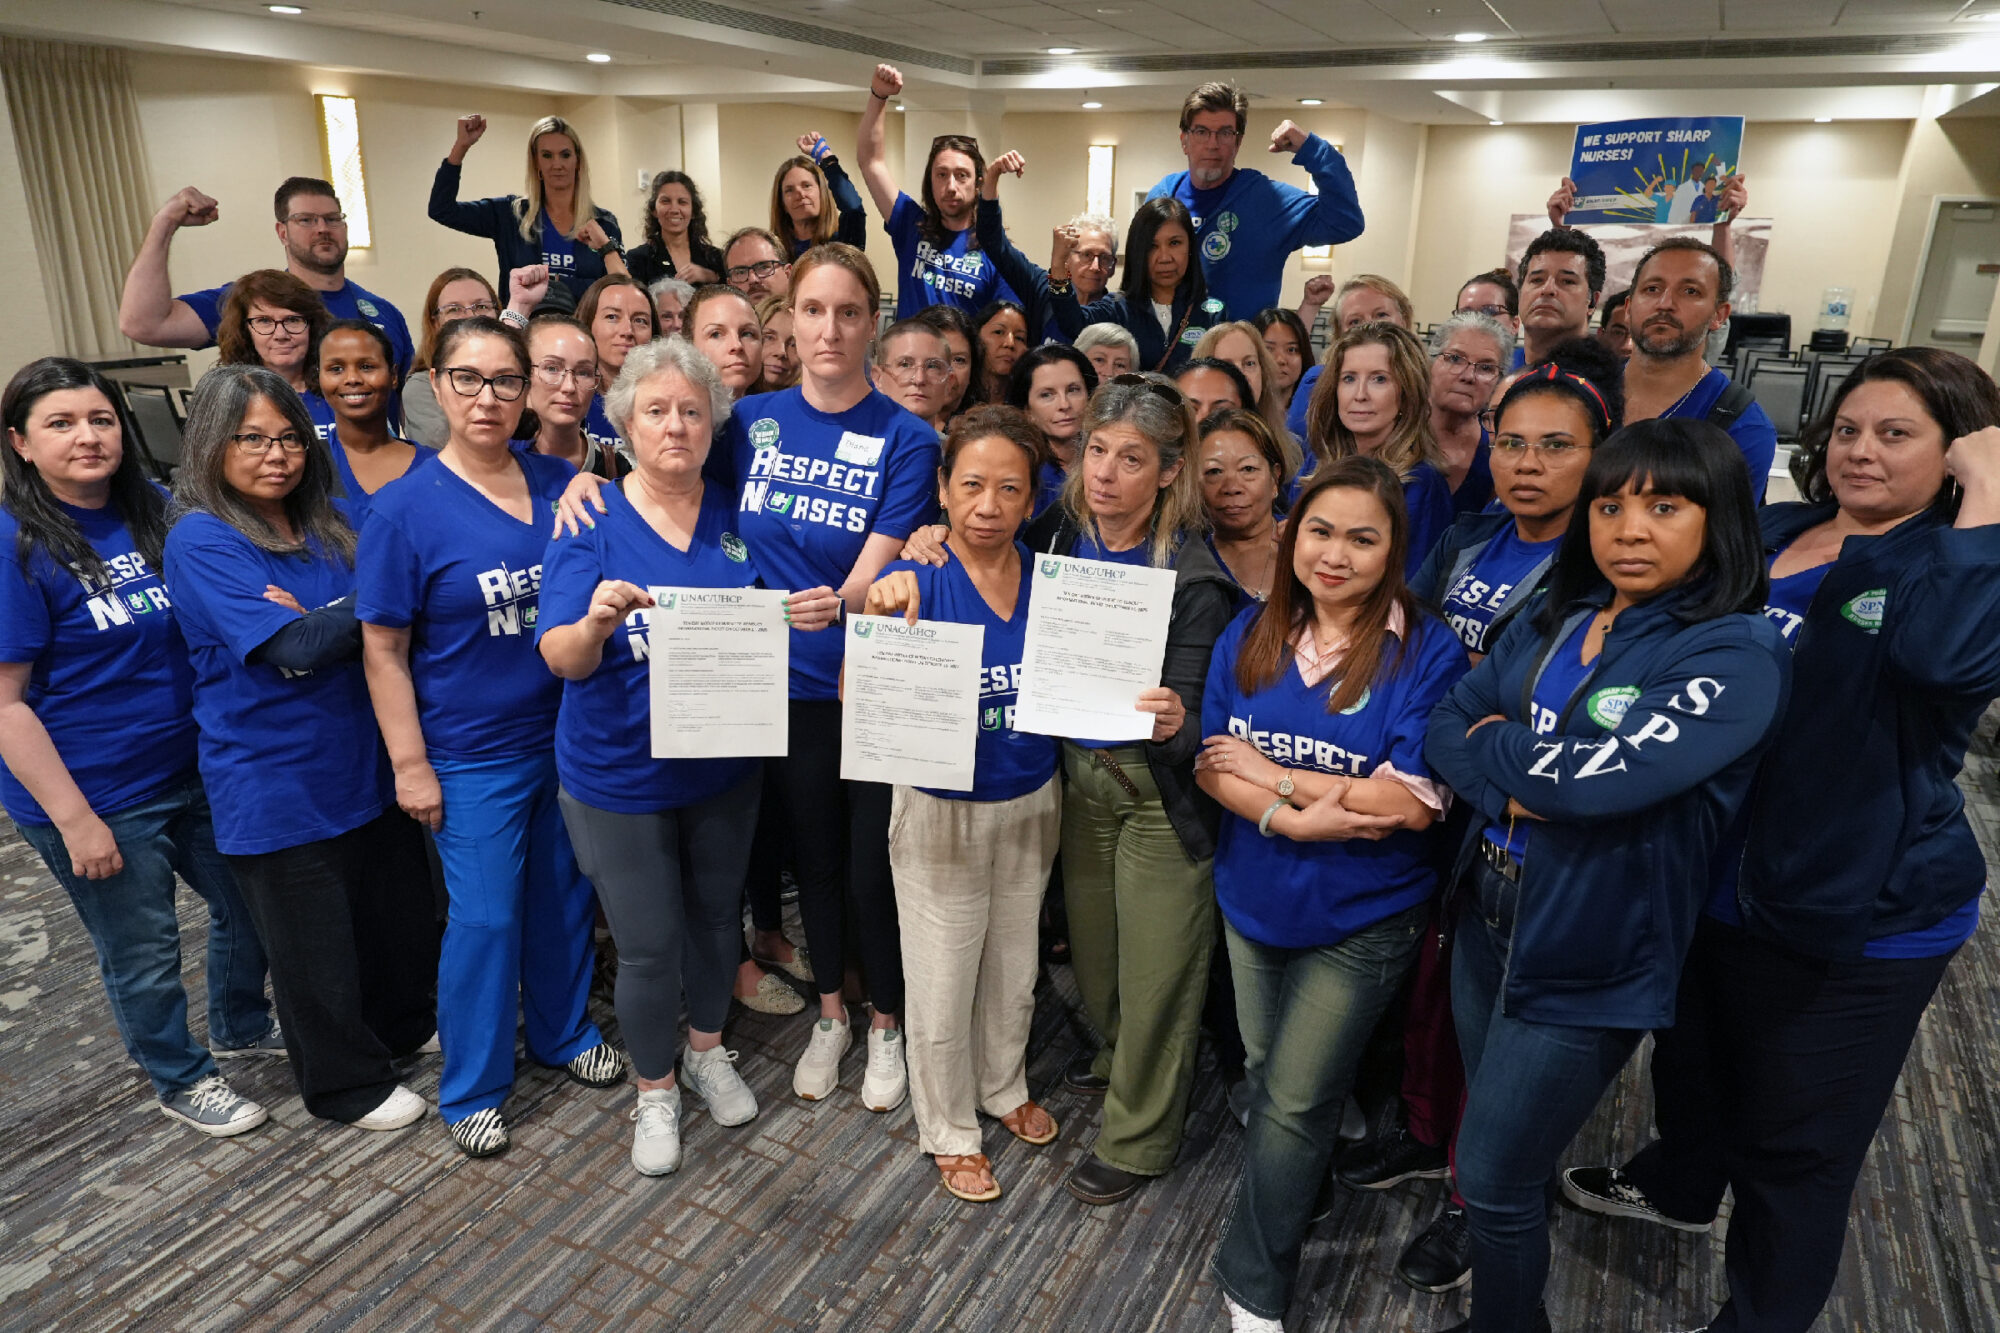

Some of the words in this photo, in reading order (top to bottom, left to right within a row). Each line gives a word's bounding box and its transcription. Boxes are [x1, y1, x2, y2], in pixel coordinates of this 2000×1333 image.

[1583, 134, 1602, 147] WE
[1605, 131, 1662, 145] SUPPORT
[1666, 129, 1711, 142] SHARP
[1580, 148, 1633, 162] NURSES!
[750, 446, 879, 495] RESPECT
[1064, 563, 1126, 579] UNAC/UHCP
[681, 594, 743, 604] UNAC/UHCP
[877, 623, 937, 638] UNAC/UHCP
